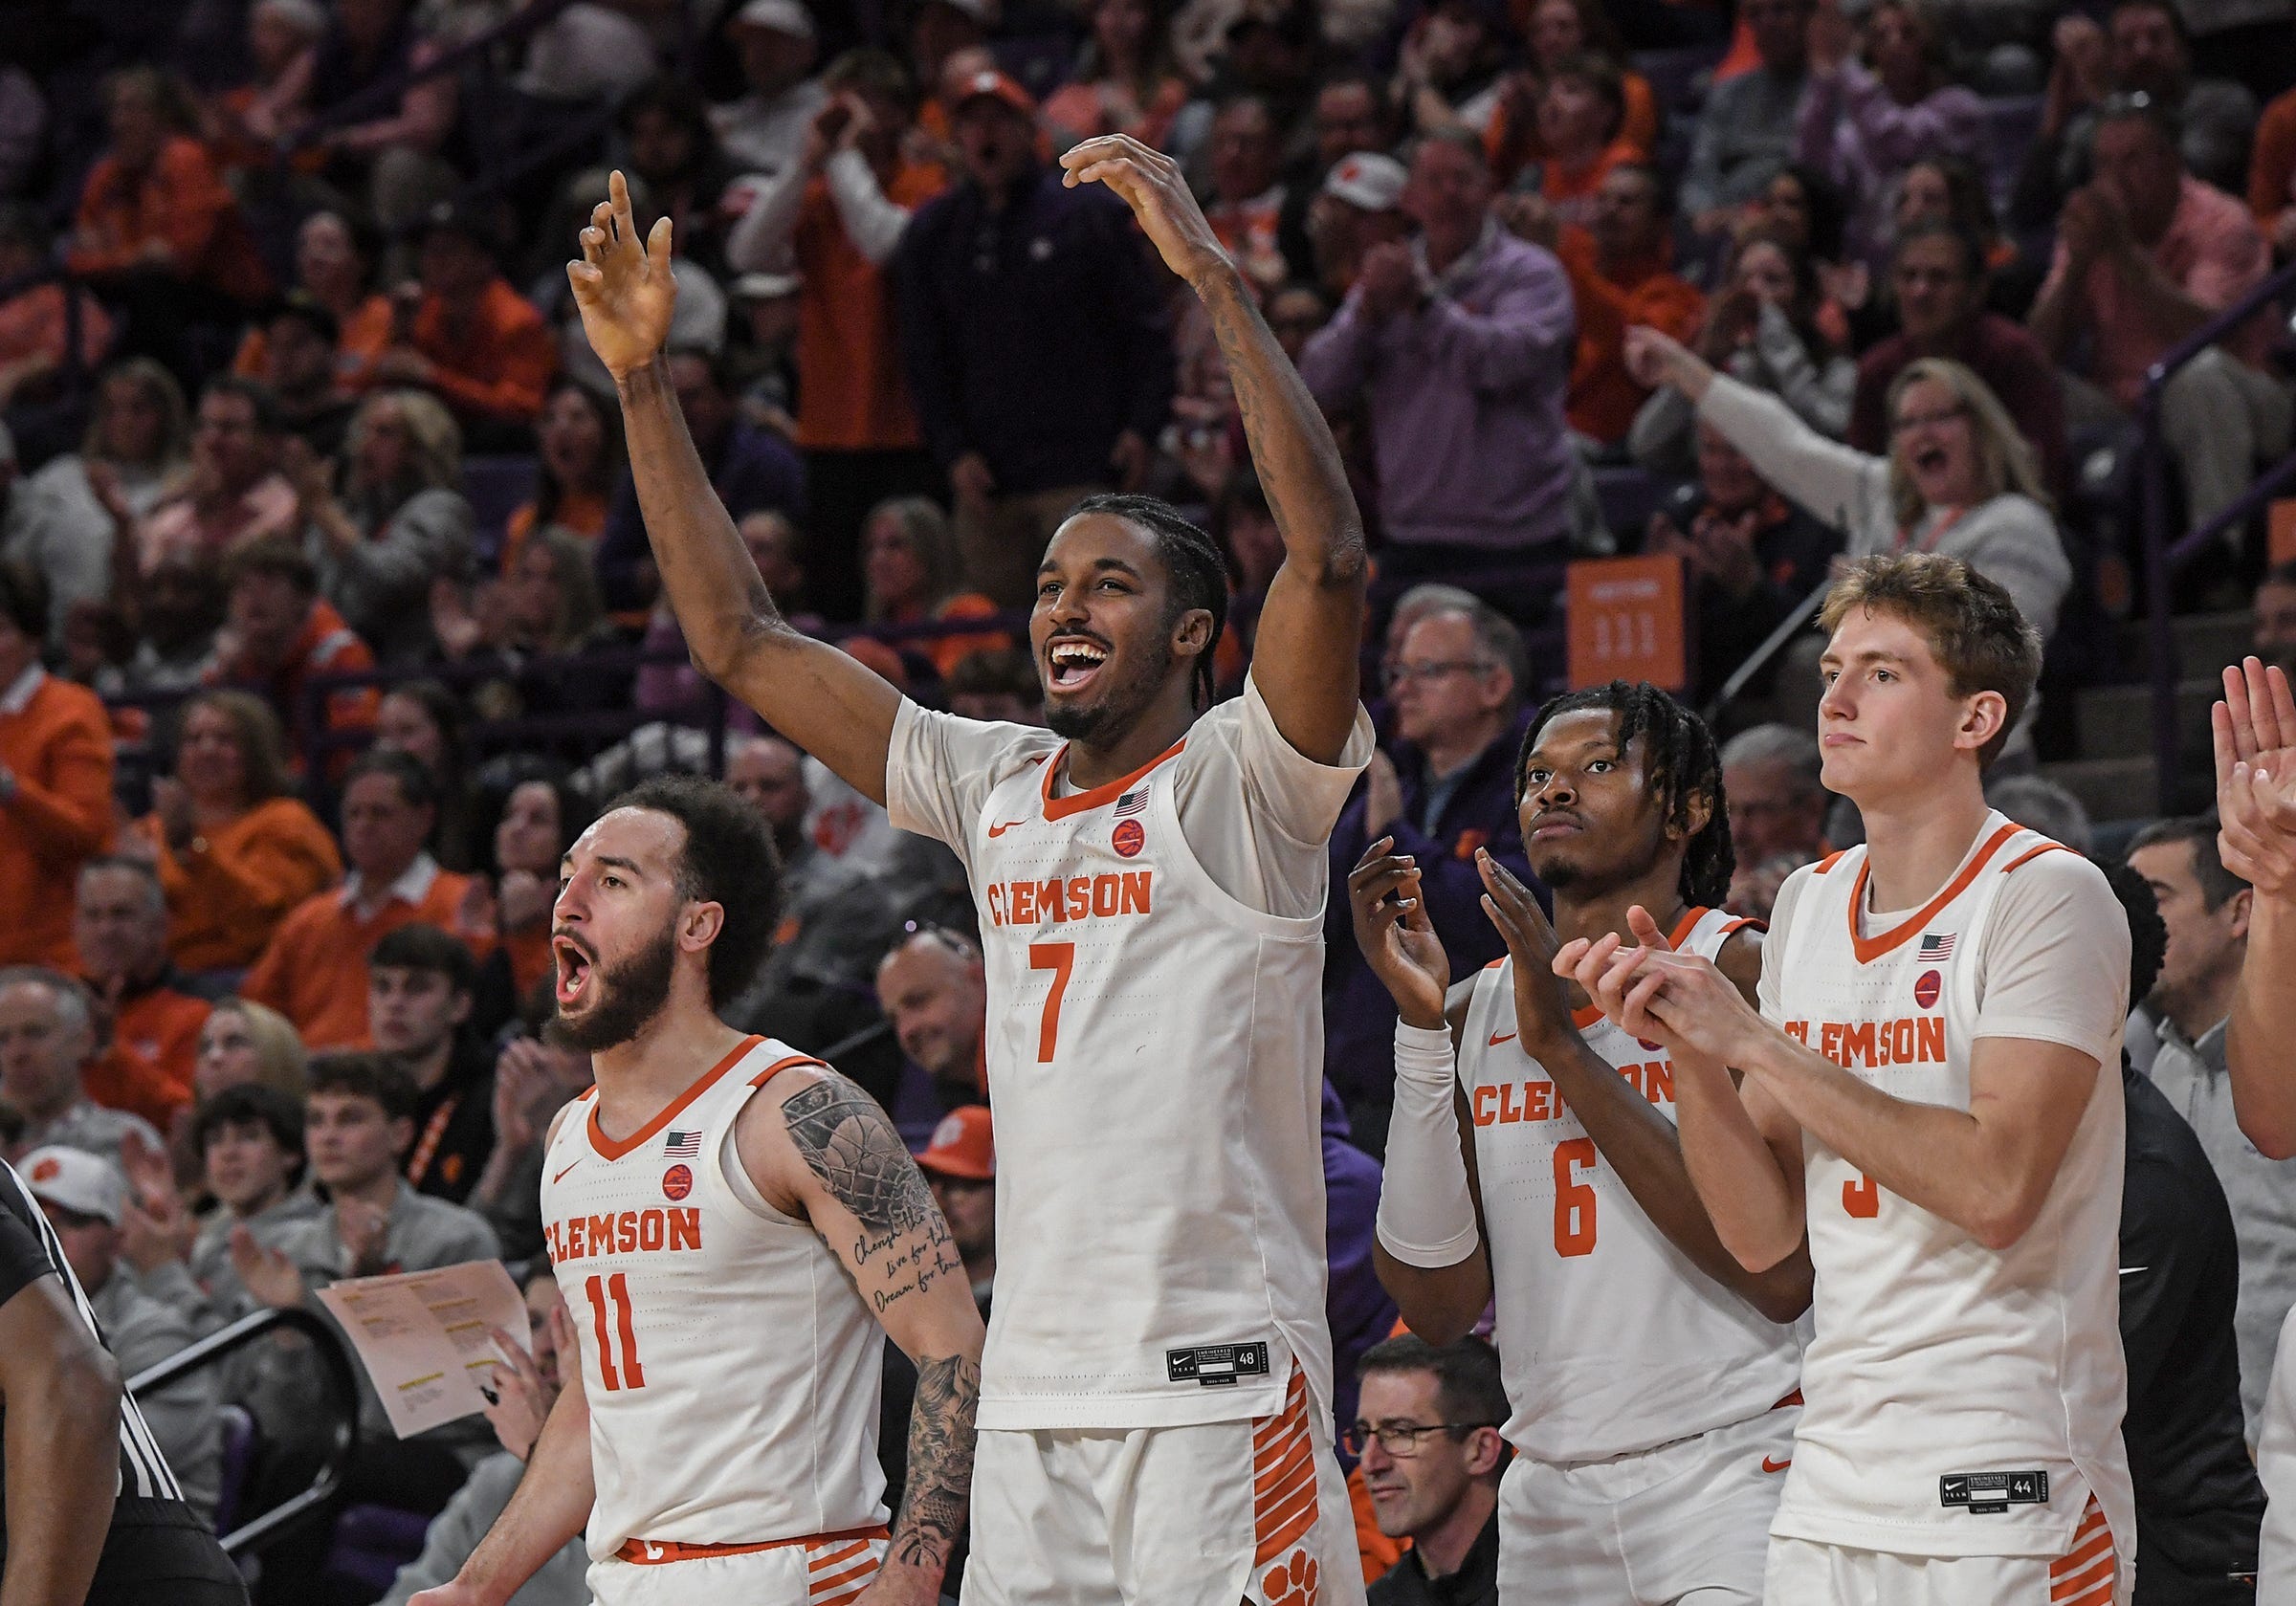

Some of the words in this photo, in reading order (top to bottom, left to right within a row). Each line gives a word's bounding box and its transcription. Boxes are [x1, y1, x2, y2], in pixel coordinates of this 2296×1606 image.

[1029, 942, 1075, 1063] 7
[1553, 1136, 1597, 1258] 6
[854, 1218, 902, 1265] Cherish
[900, 1206, 925, 1232] the
[886, 1255, 907, 1279] Live
[911, 1244, 927, 1265] for
[873, 1284, 916, 1313] Dream
[917, 1270, 935, 1293] for
[585, 1272, 646, 1392] 11
[1239, 1352, 1254, 1365] 48
[2014, 1480, 2031, 1493] 44
